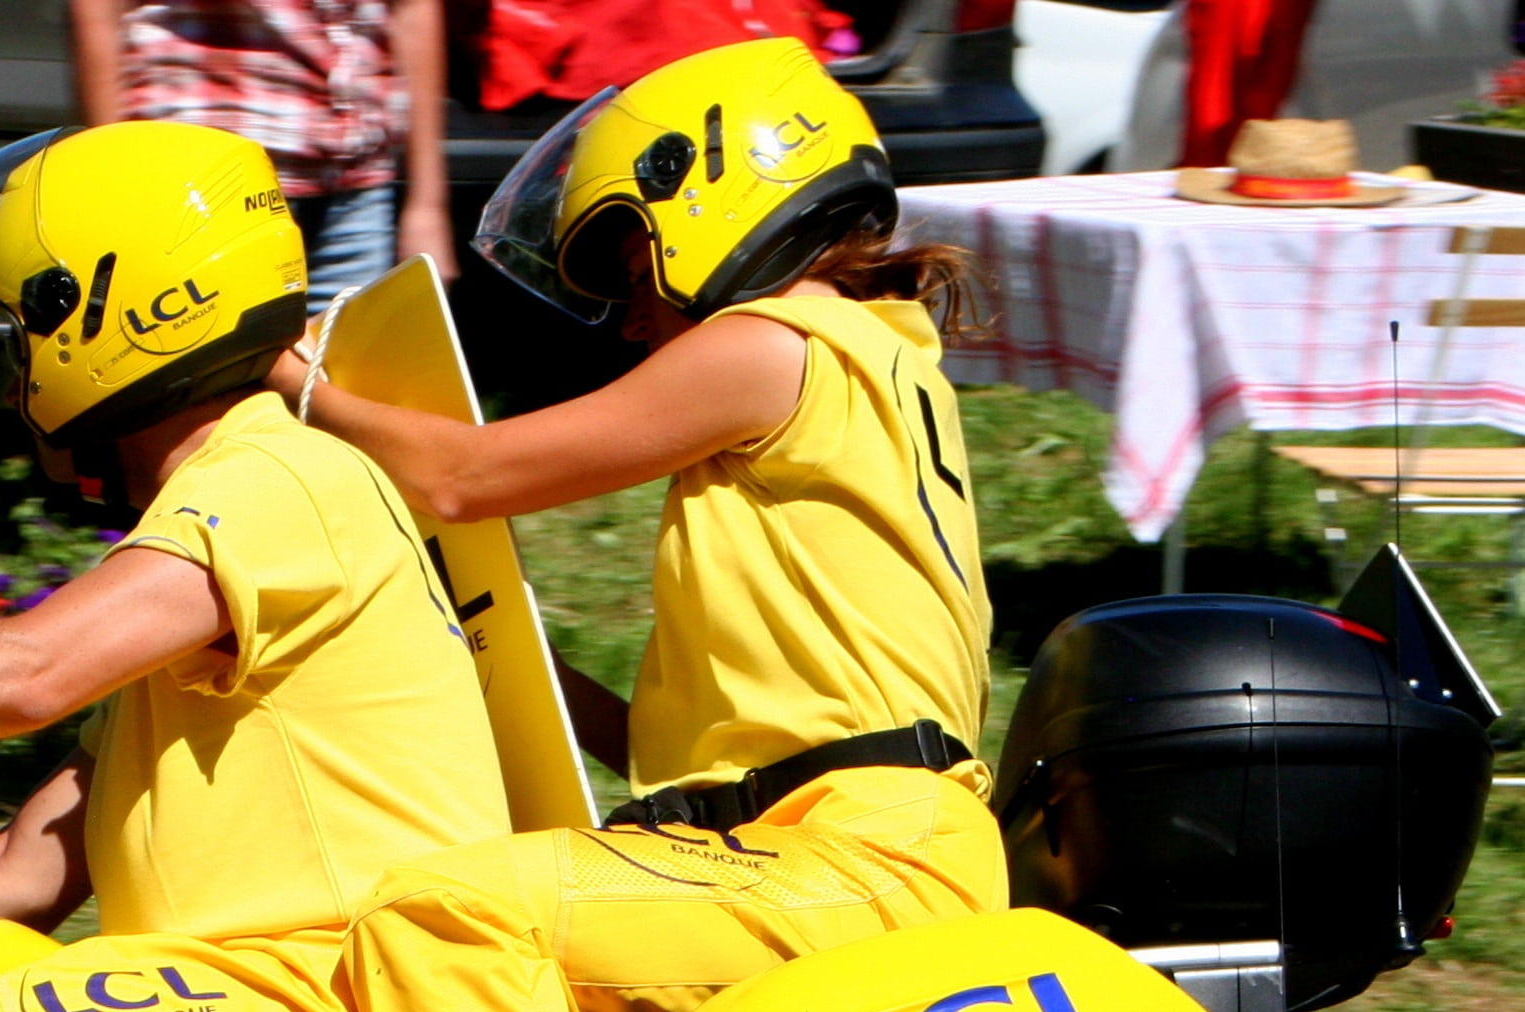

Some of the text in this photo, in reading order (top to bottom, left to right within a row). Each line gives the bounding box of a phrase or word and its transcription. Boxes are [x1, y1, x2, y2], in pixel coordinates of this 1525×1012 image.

[748, 112, 827, 168] LCL
[125, 278, 220, 335] LCL
[172, 302, 217, 330] BANQUE
[670, 843, 767, 871] BANQUE
